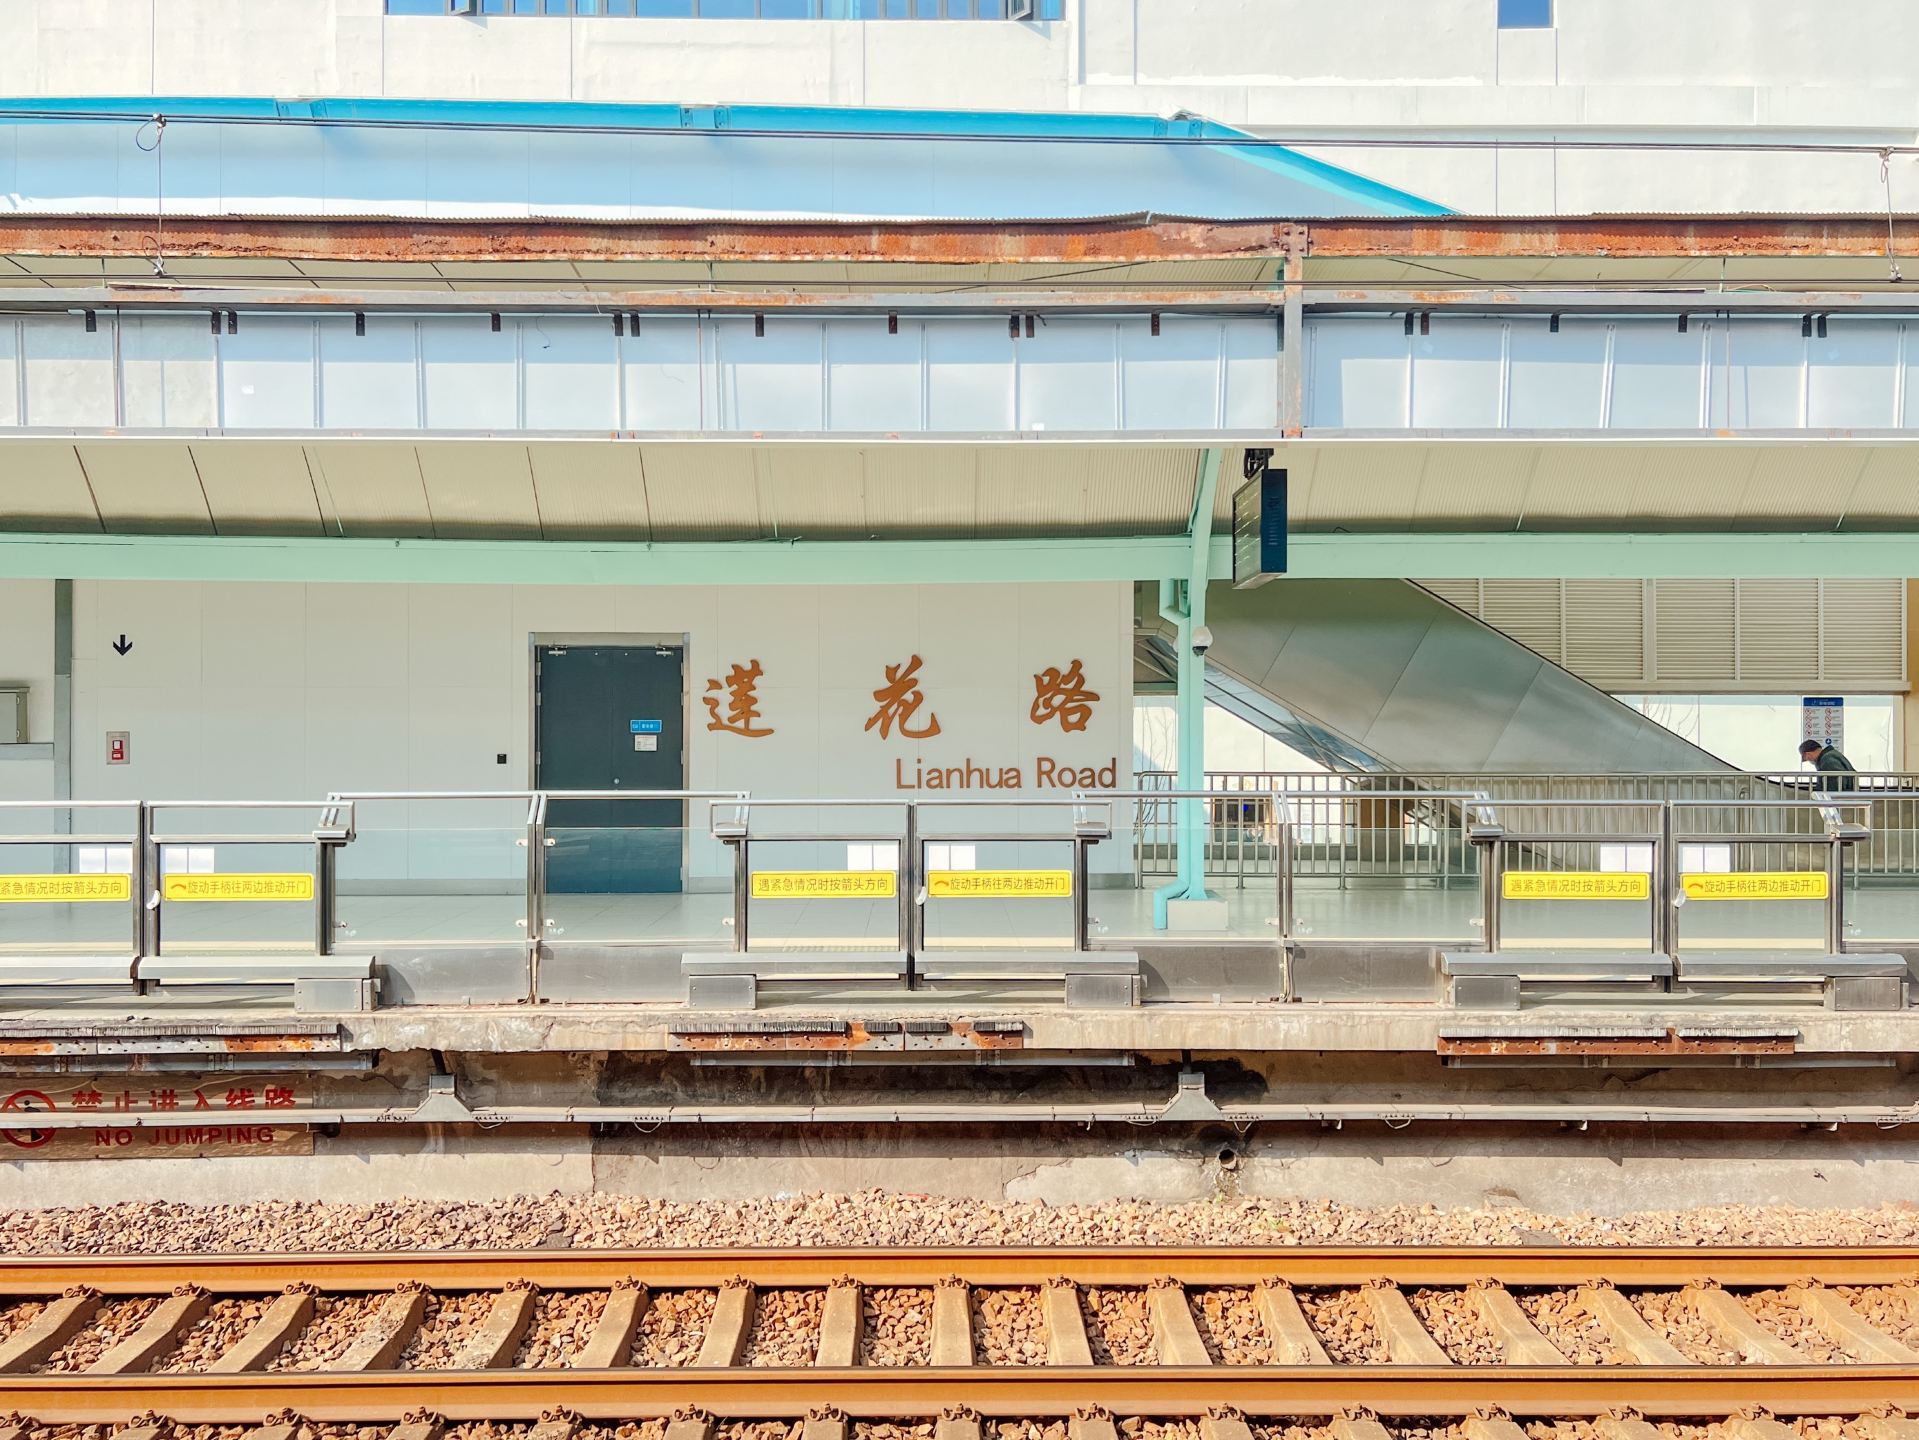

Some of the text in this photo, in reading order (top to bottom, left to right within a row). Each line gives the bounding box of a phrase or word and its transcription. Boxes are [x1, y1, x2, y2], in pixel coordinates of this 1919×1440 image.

[896, 757, 1117, 789] Lianhua Road
[187, 880, 307, 894] 旋动手柄往两边推动开门
[758, 878, 888, 891] 遇紧急情况时按箭头方向
[950, 877, 1065, 891] 旋动手柄往两边推动开门
[1511, 879, 1641, 892] 遇紧急情况时按箭头方向
[1704, 879, 1821, 893] 旋动手柄往两边推动开门
[94, 1126, 274, 1147] NO JUMPING
